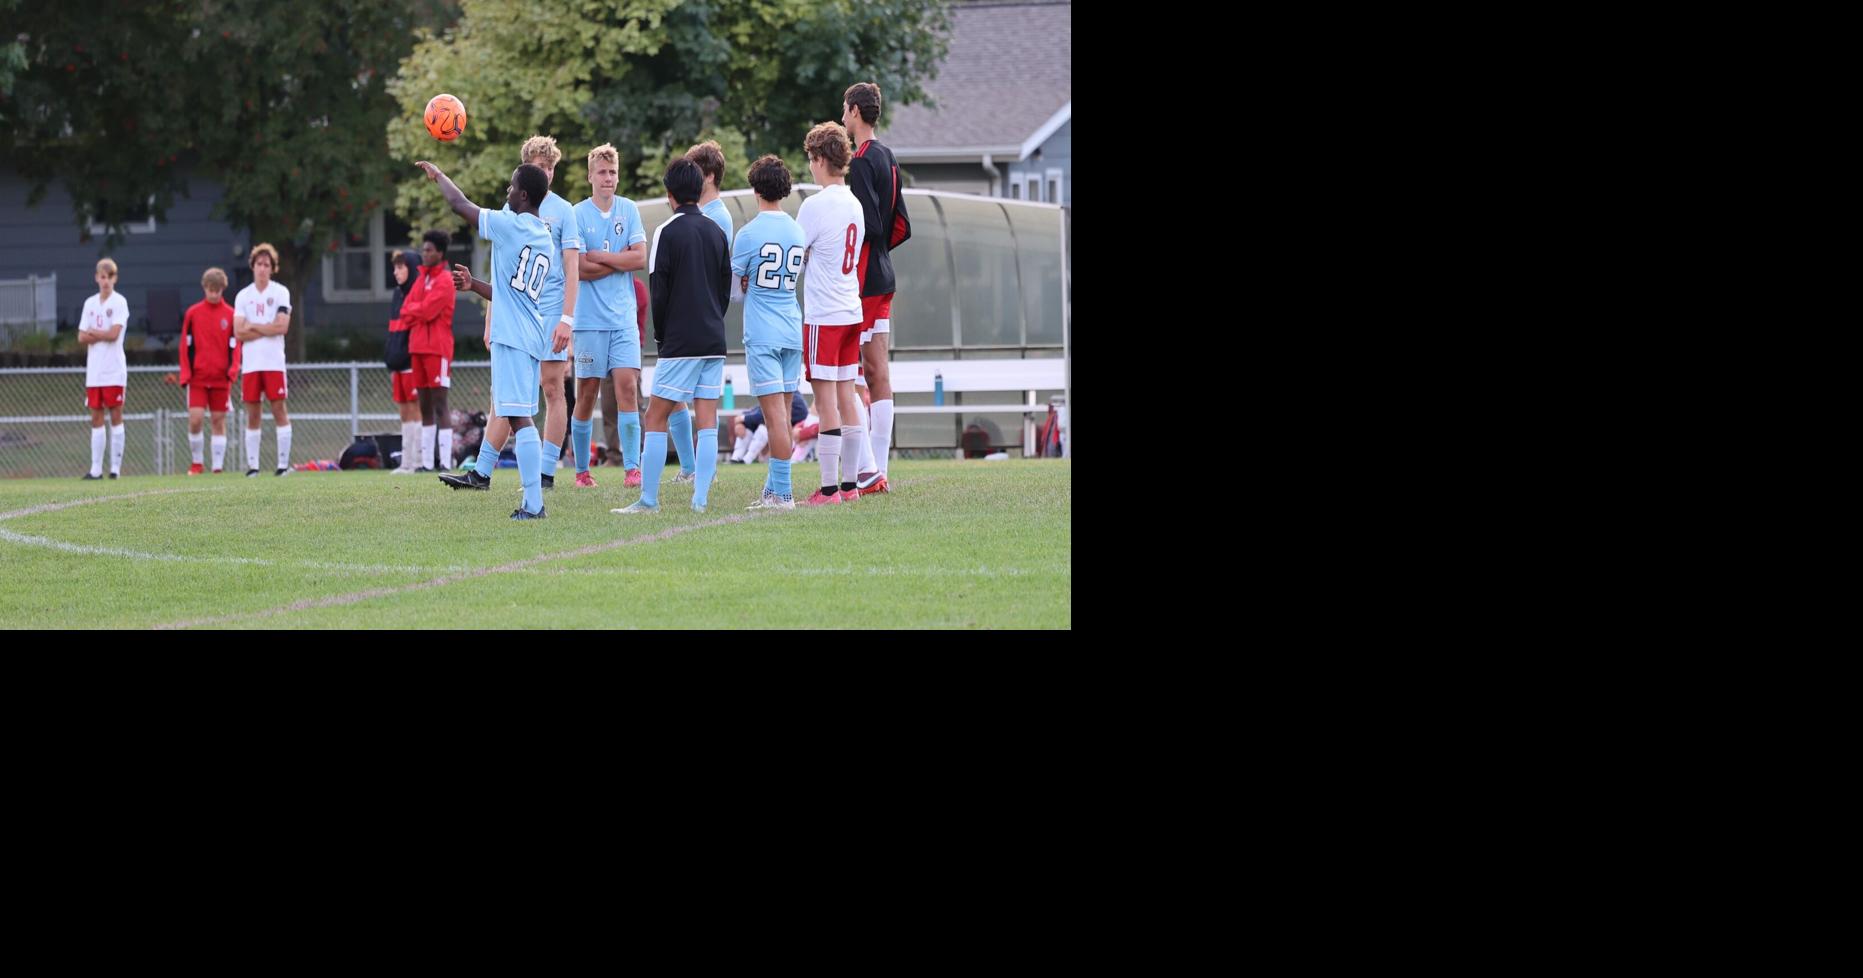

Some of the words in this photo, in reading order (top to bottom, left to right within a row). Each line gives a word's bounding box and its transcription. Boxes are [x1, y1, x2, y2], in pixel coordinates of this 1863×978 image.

[510, 245, 550, 302] 10
[756, 242, 804, 291] 29
[842, 223, 857, 275] 8
